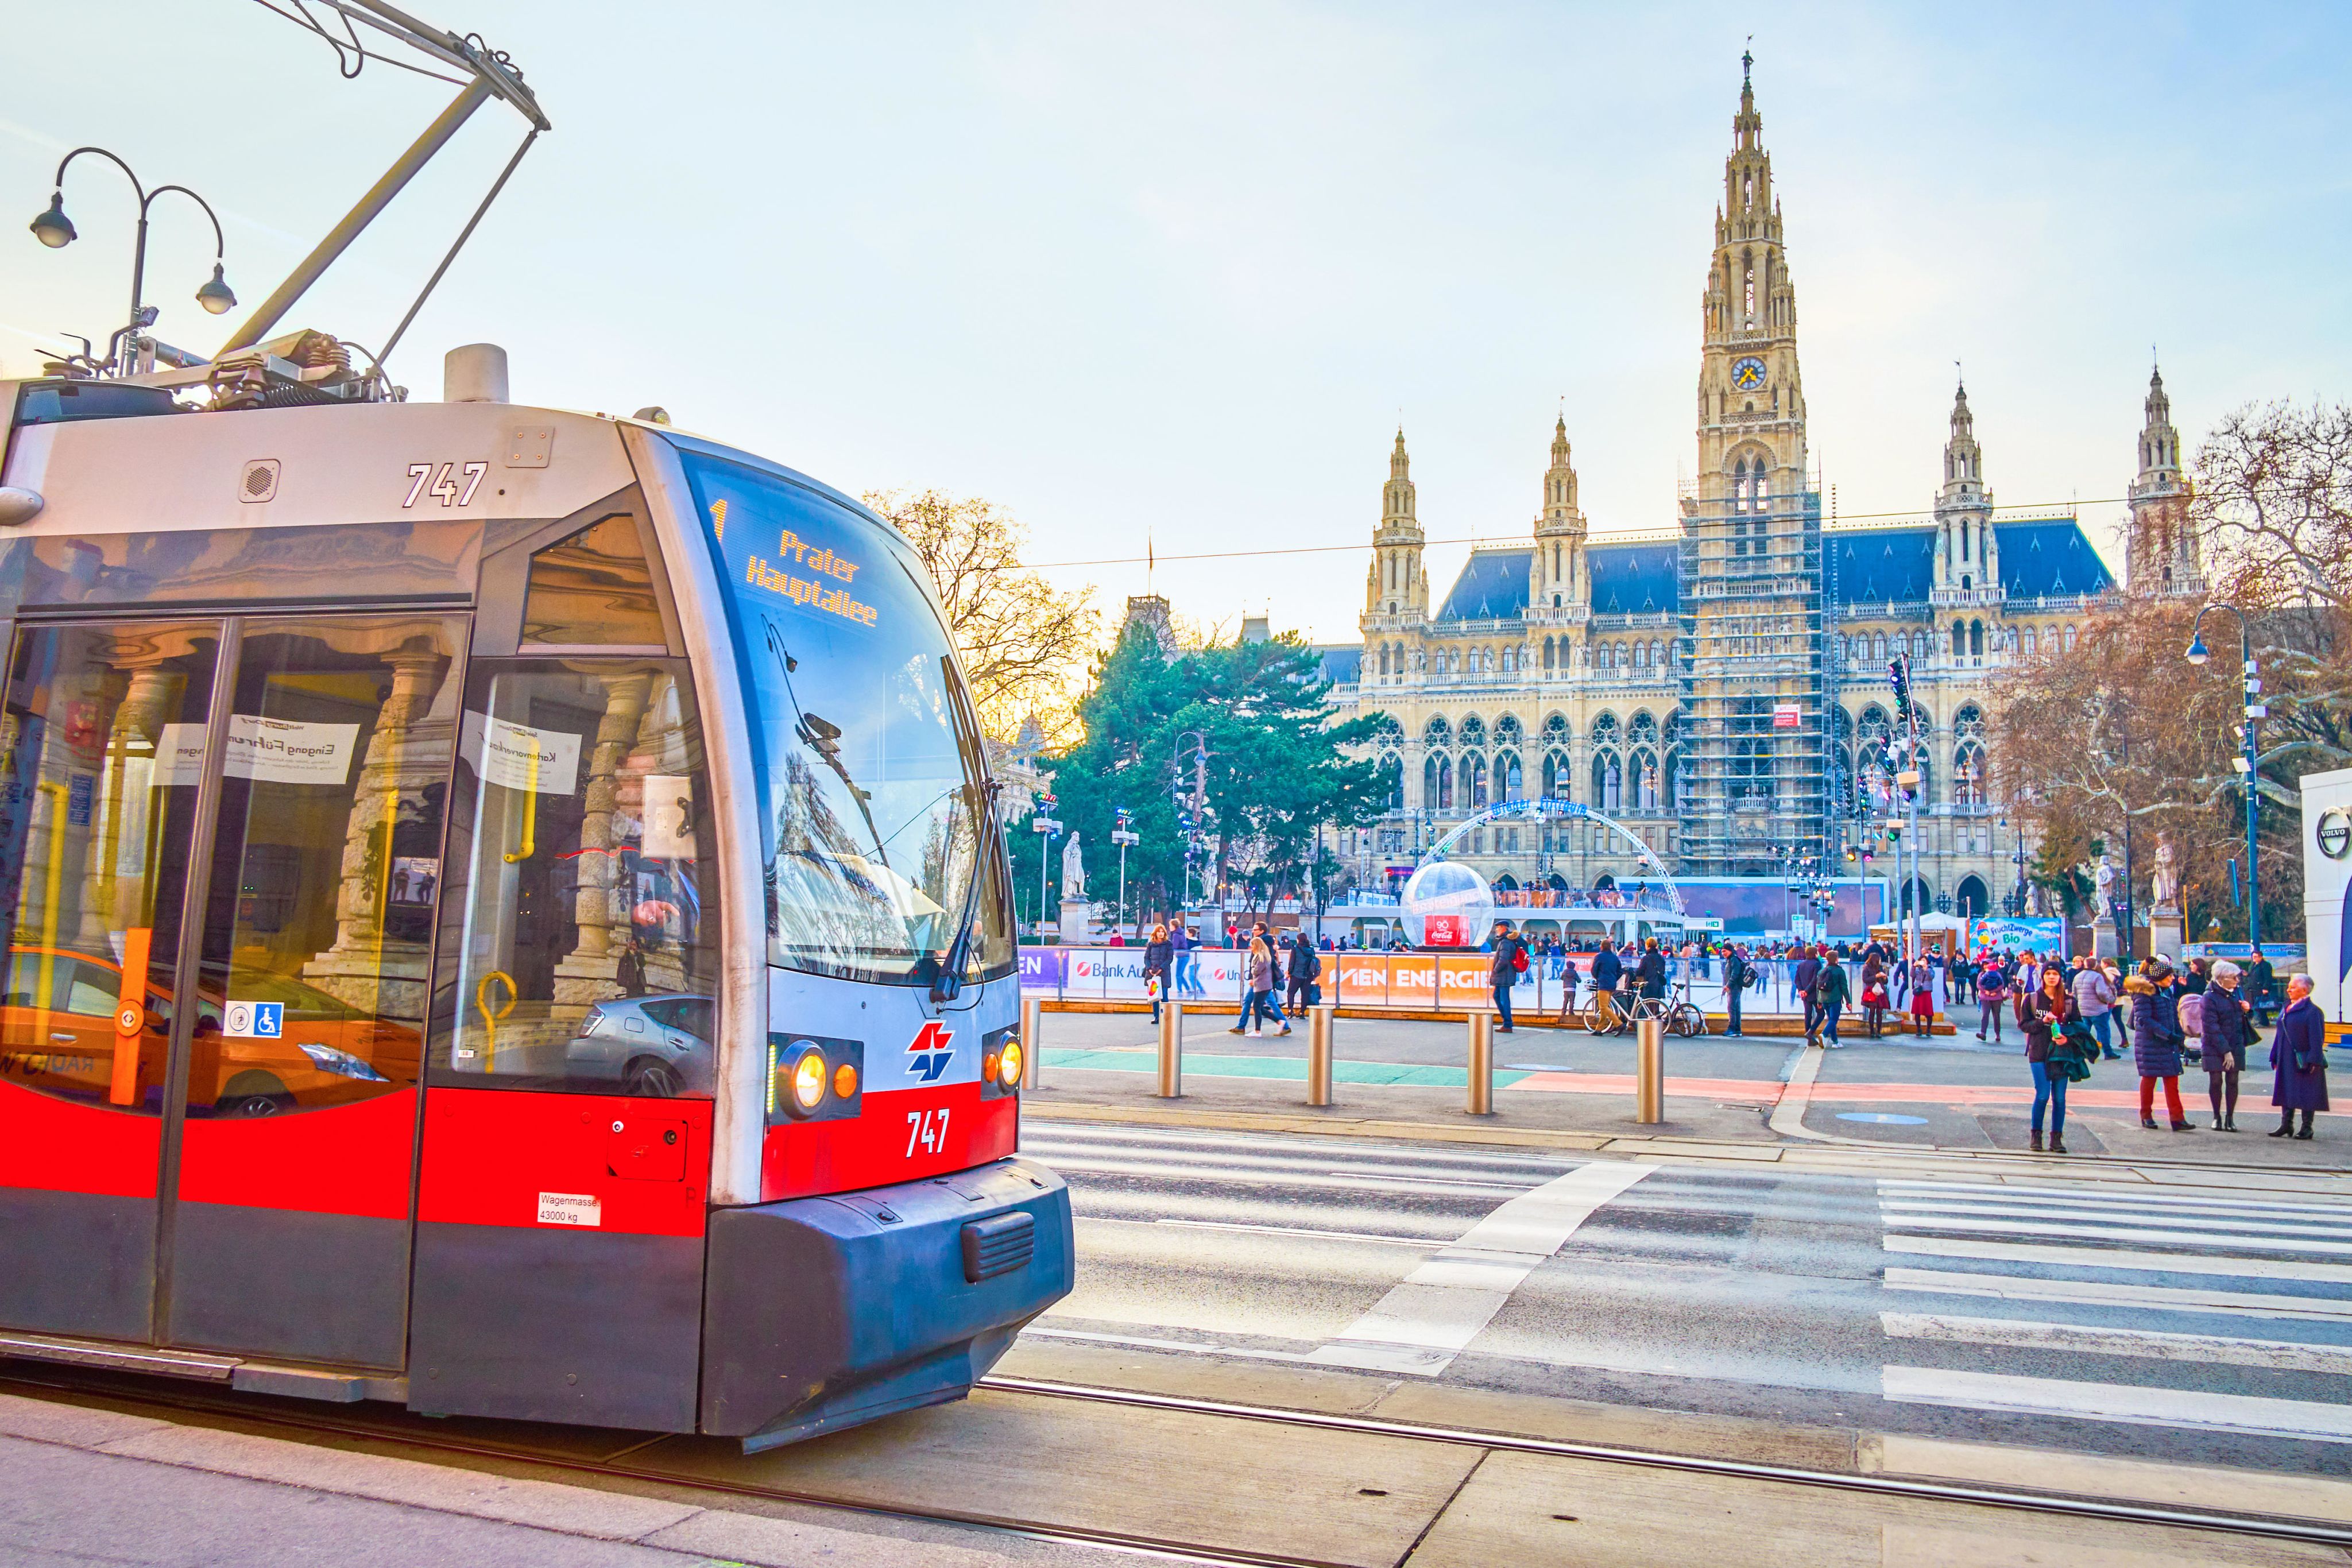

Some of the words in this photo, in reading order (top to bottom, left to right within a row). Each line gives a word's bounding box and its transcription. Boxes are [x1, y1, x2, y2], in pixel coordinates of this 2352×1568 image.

[402, 461, 489, 508] 747
[709, 499, 728, 543] 1
[780, 529, 860, 583] Prater
[746, 555, 877, 628] Hauptallee
[2320, 828, 2346, 837] VOLVO
[1991, 924, 2033, 936] FruchtZwerge
[2003, 934, 2020, 944] Bio
[1093, 963, 1124, 977] Bank
[1329, 969, 1386, 986] WIEN
[1396, 969, 1494, 988] ENERGIE
[906, 1108, 950, 1159] 747
[540, 1210, 566, 1221] 43000
[567, 1212, 578, 1224] kg
